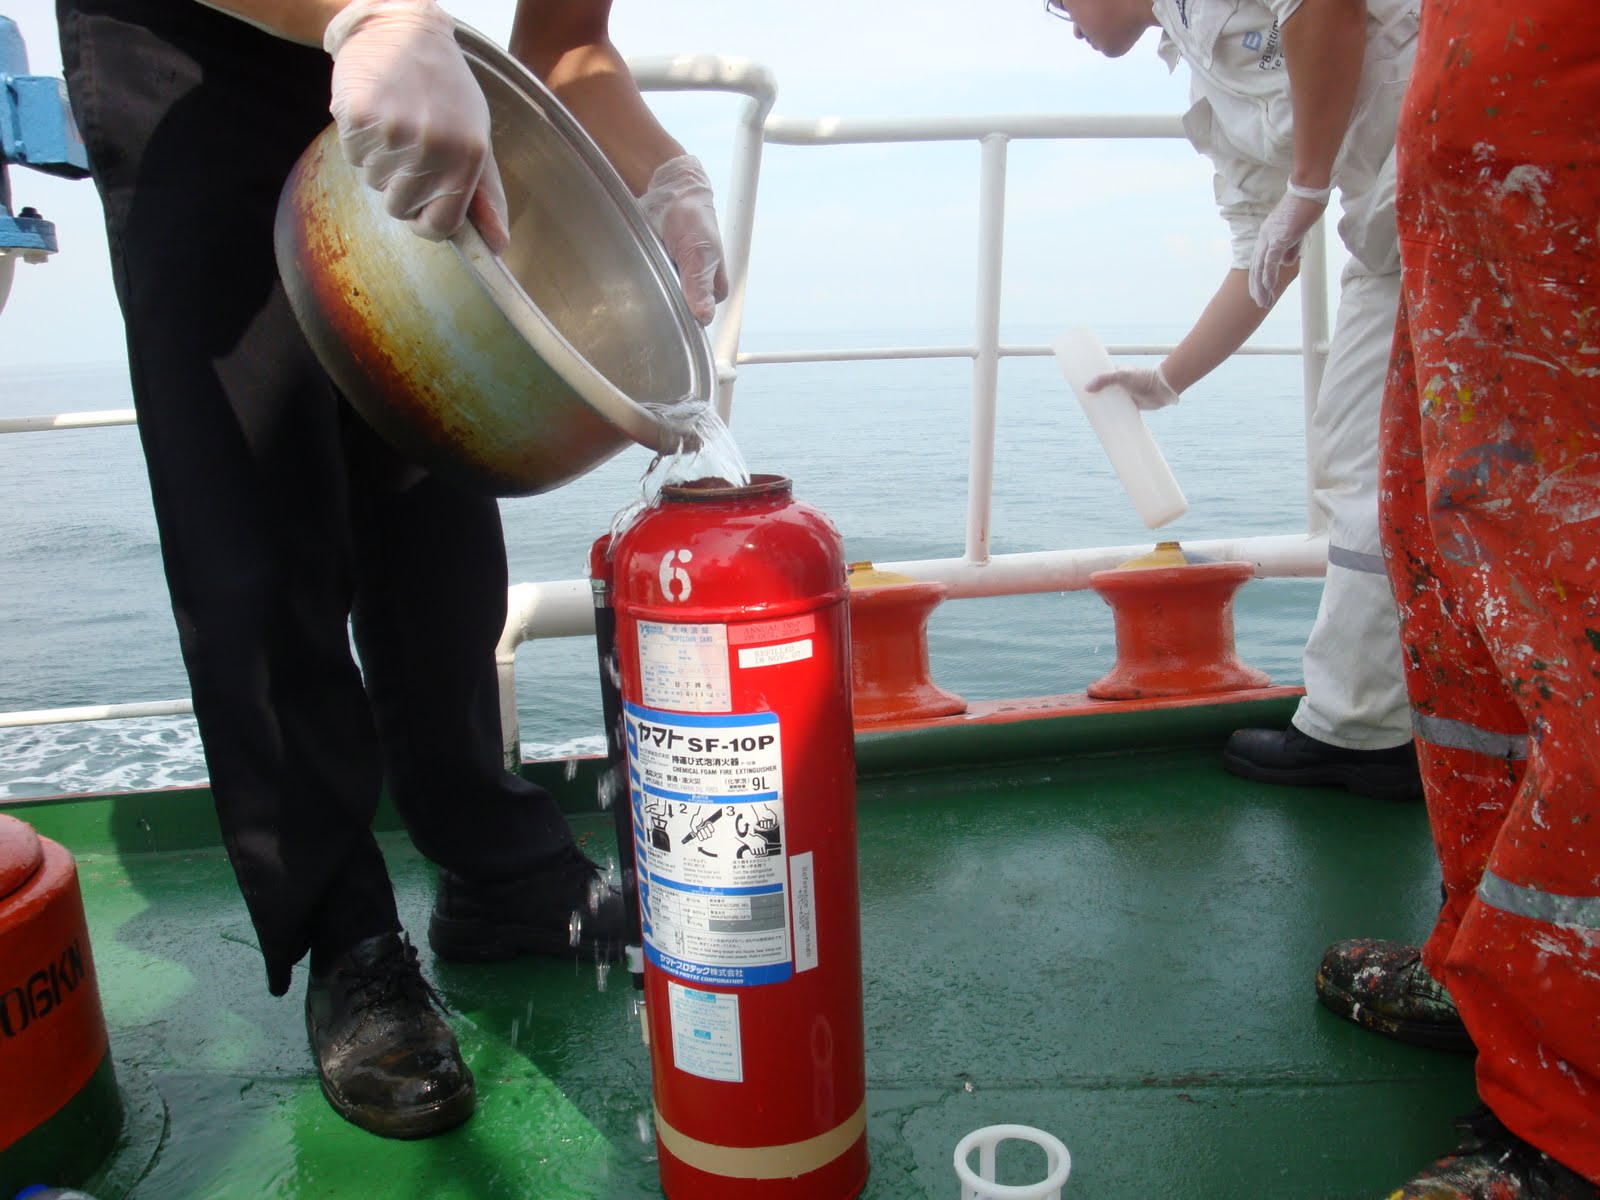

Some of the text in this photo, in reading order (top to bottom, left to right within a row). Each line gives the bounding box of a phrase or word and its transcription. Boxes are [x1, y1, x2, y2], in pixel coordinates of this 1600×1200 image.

[659, 549, 693, 603] 6
[754, 646, 795, 657] REFILLED
[638, 722, 775, 753] ヤマト SF-10P
[673, 766, 699, 775] CHEMICAL
[735, 765, 777, 775] EXTINGUISHER
[752, 776, 770, 791] 9L
[679, 803, 688, 814] 2
[726, 805, 736, 816] 3
[659, 953, 744, 978] ヤマトプロテック株式会社
[700, 976, 744, 984] CORPORATION
